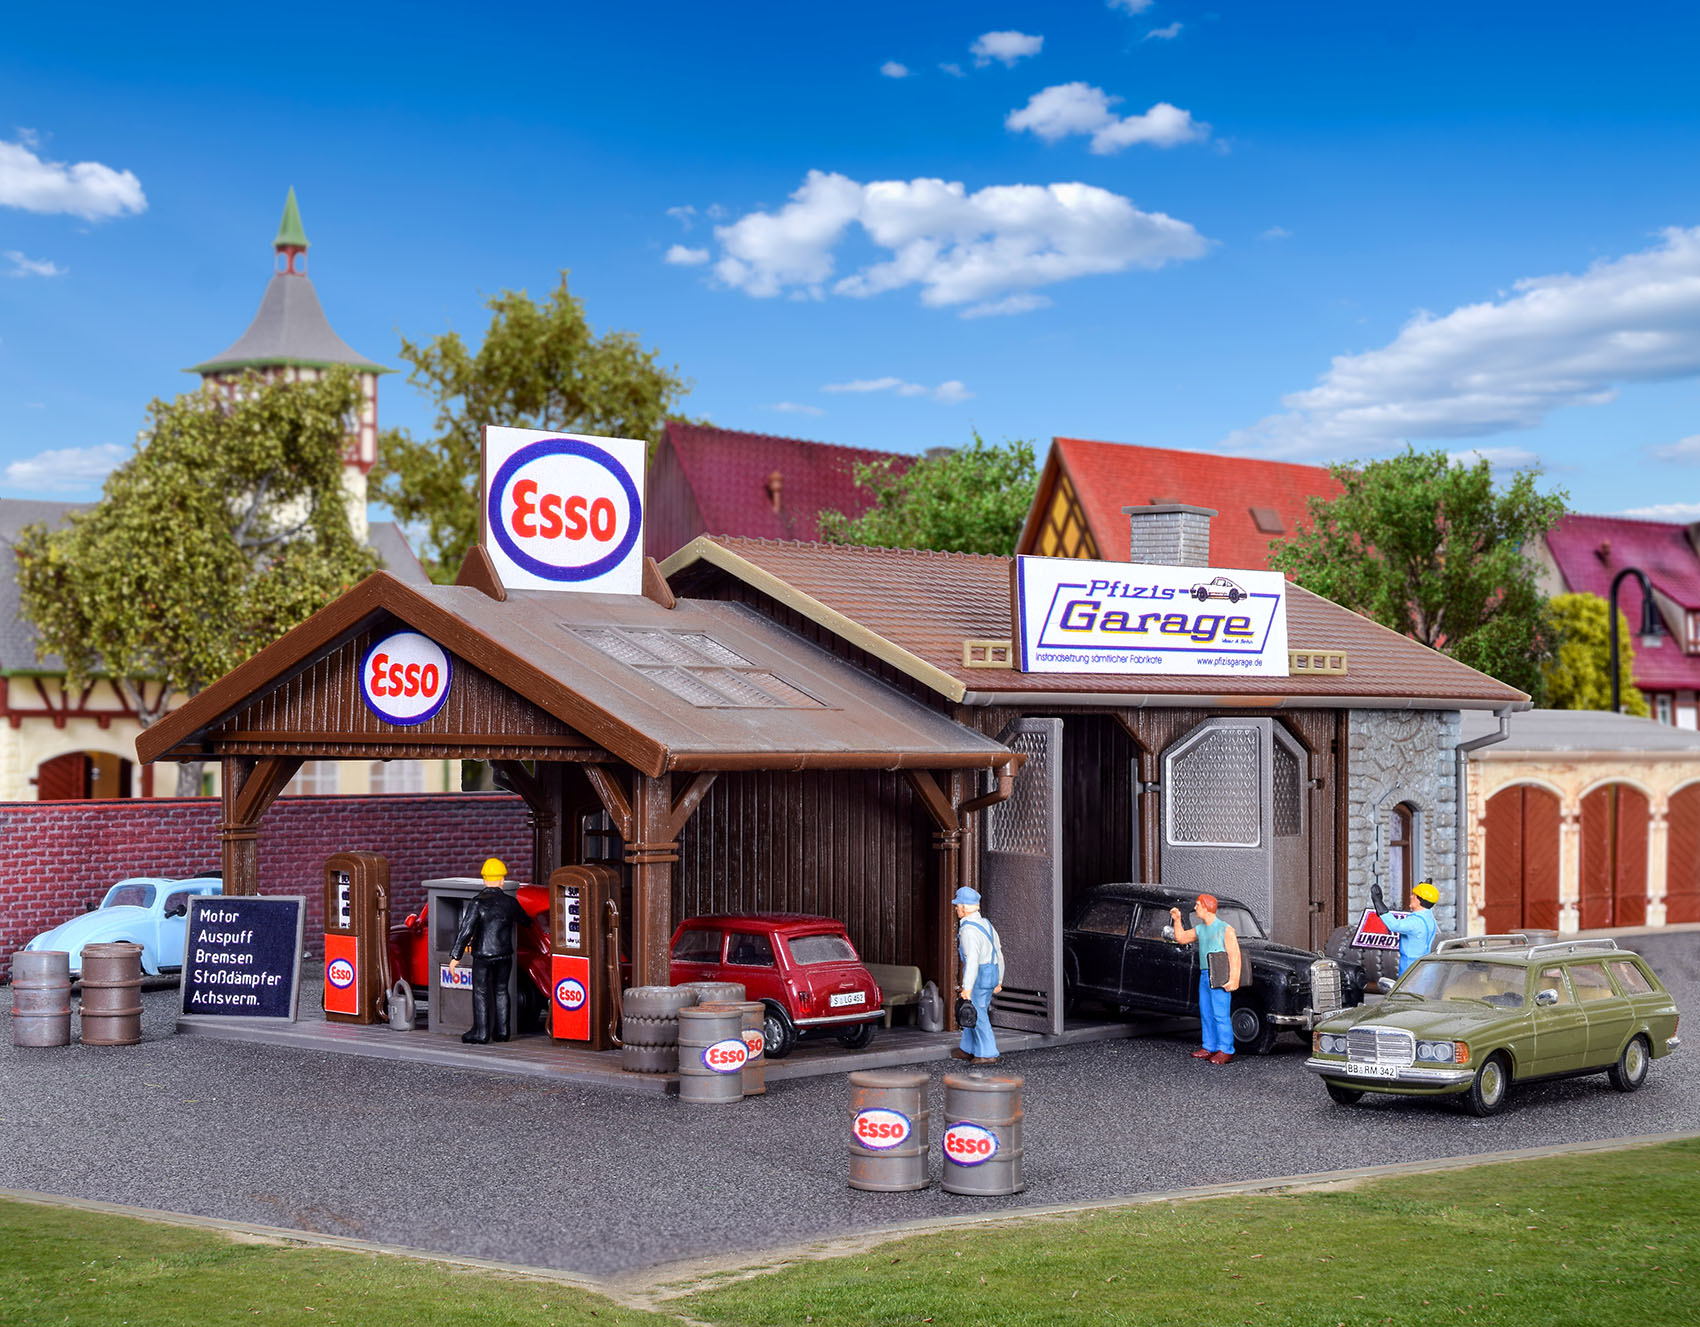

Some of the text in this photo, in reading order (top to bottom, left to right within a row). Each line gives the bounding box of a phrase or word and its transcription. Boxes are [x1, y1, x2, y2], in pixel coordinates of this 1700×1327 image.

[511, 479, 617, 542] Esso
[1085, 580, 1176, 600] Pfizis
[1059, 599, 1255, 644] Garage
[1035, 652, 1163, 665] Instandsetzung sämtlicher Fabrikate
[1196, 656, 1263, 669] www.pfizisgarage.de
[370, 652, 440, 698] Esso
[199, 908, 240, 923] Motor
[198, 929, 254, 947] Auspuff
[1356, 933, 1400, 948] UNIROY
[195, 948, 254, 965] Bremsen
[193, 970, 282, 989] Stoßdämpfer
[331, 965, 351, 981] Esso
[442, 969, 472, 985] Mobi
[191, 990, 260, 1006] Achsverm.
[559, 986, 582, 1002] Esso
[844, 994, 853, 1004] LG
[853, 993, 864, 1003] 452
[709, 1048, 745, 1065] Esso
[1347, 1064, 1395, 1077] BB RM 342
[857, 1117, 905, 1139] Esso
[946, 1132, 992, 1155] Esso
